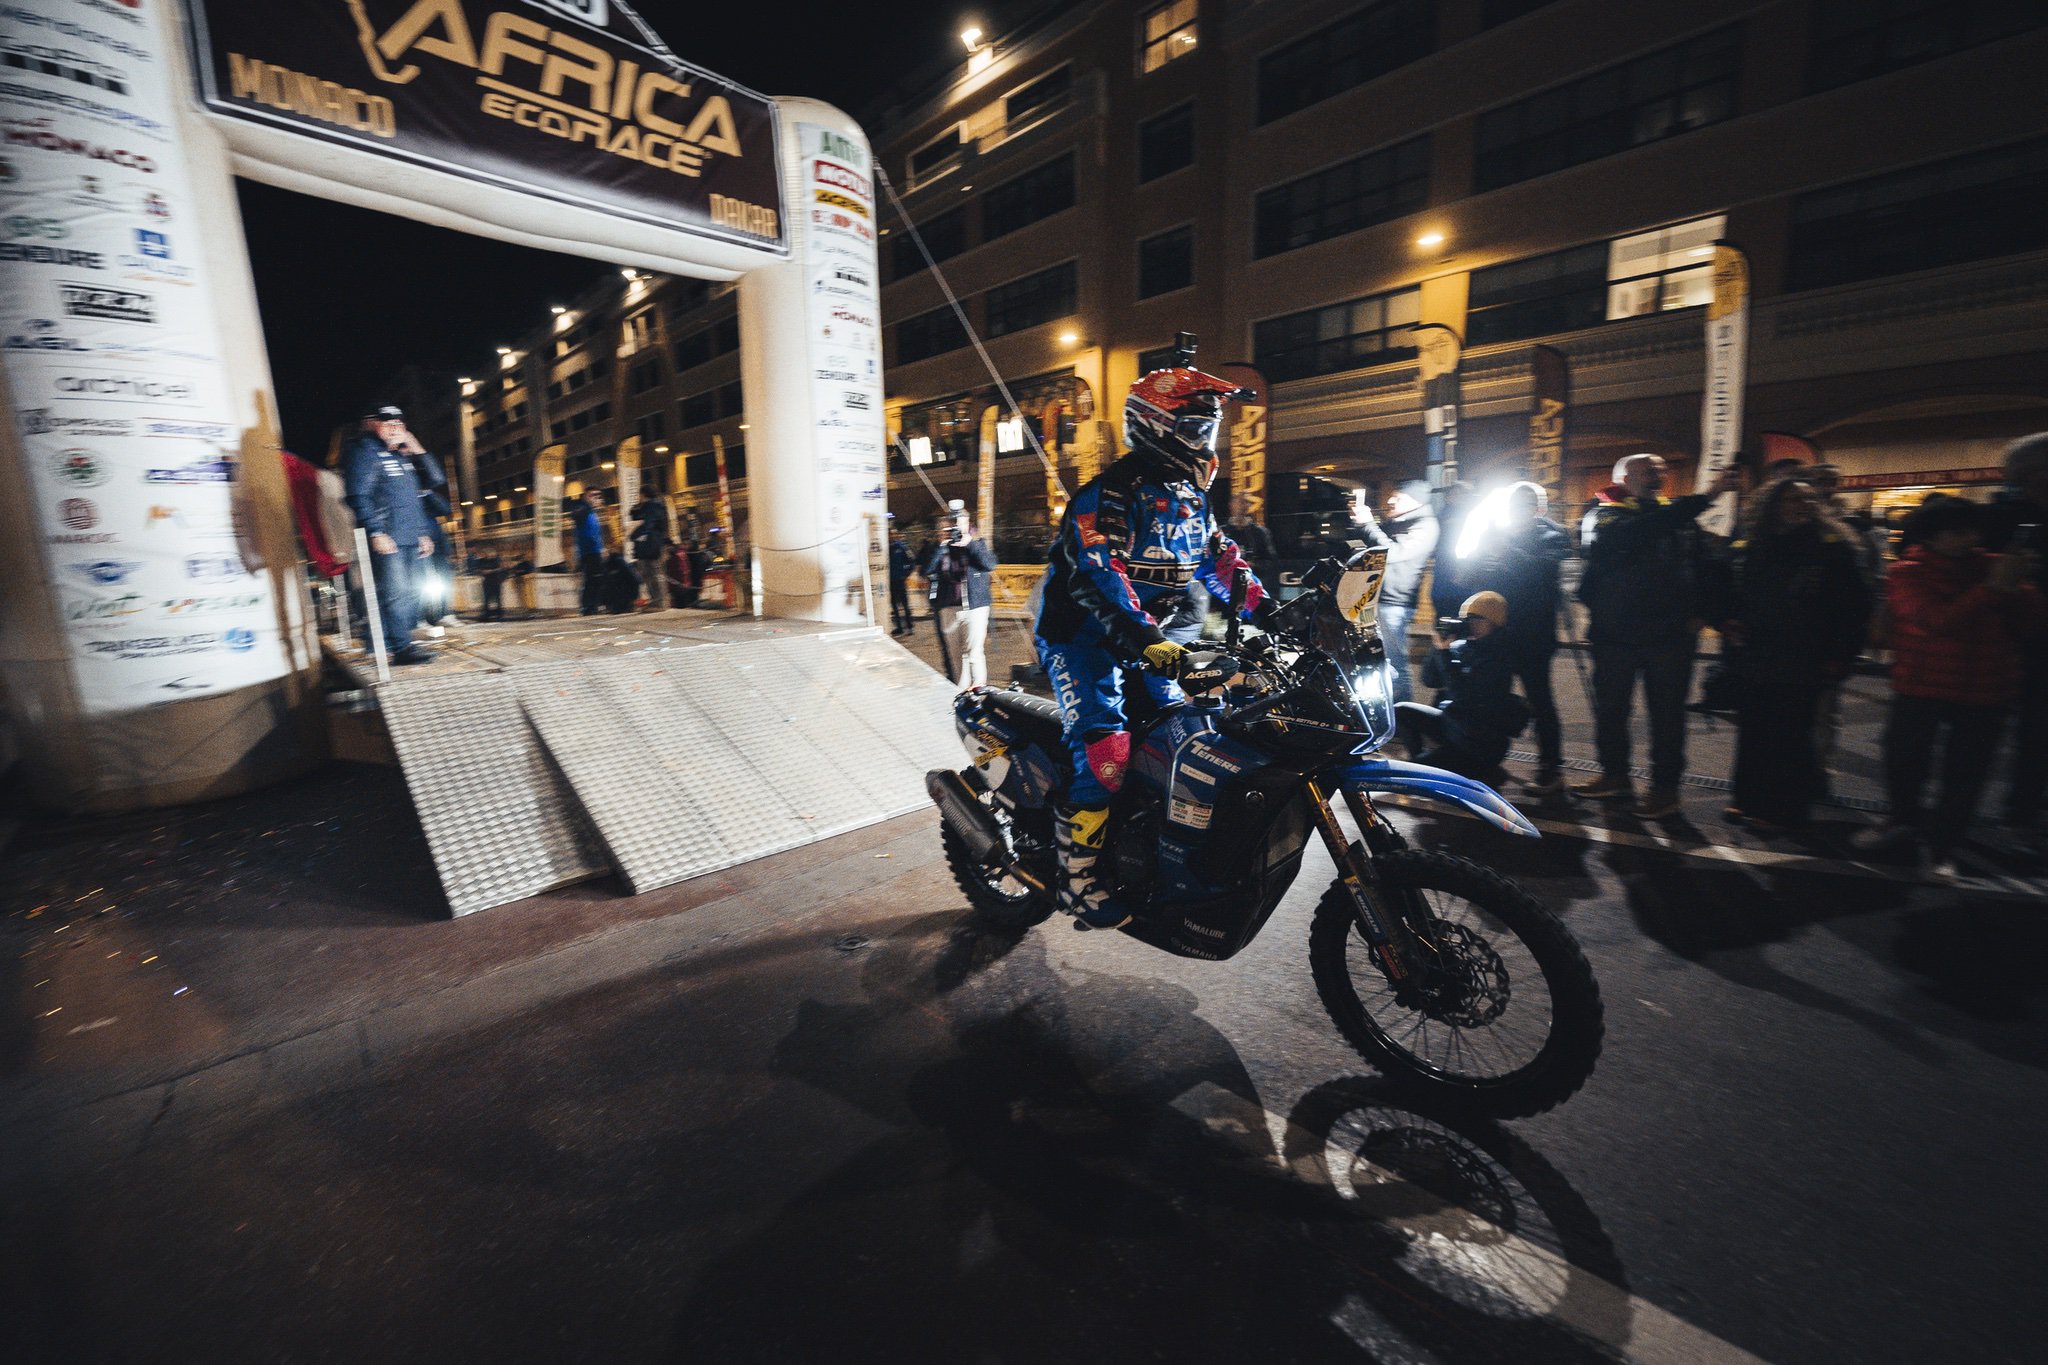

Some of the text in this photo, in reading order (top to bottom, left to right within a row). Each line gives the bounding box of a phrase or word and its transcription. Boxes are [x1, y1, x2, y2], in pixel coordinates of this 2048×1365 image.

[226, 52, 397, 138] MONACO
[377, 0, 743, 157] AFRICA
[480, 93, 703, 177] ECORACE
[709, 193, 778, 239] DAKAR
[1180, 943, 1218, 960] YAMAHA
[1182, 917, 1227, 939] YAMALUBE
